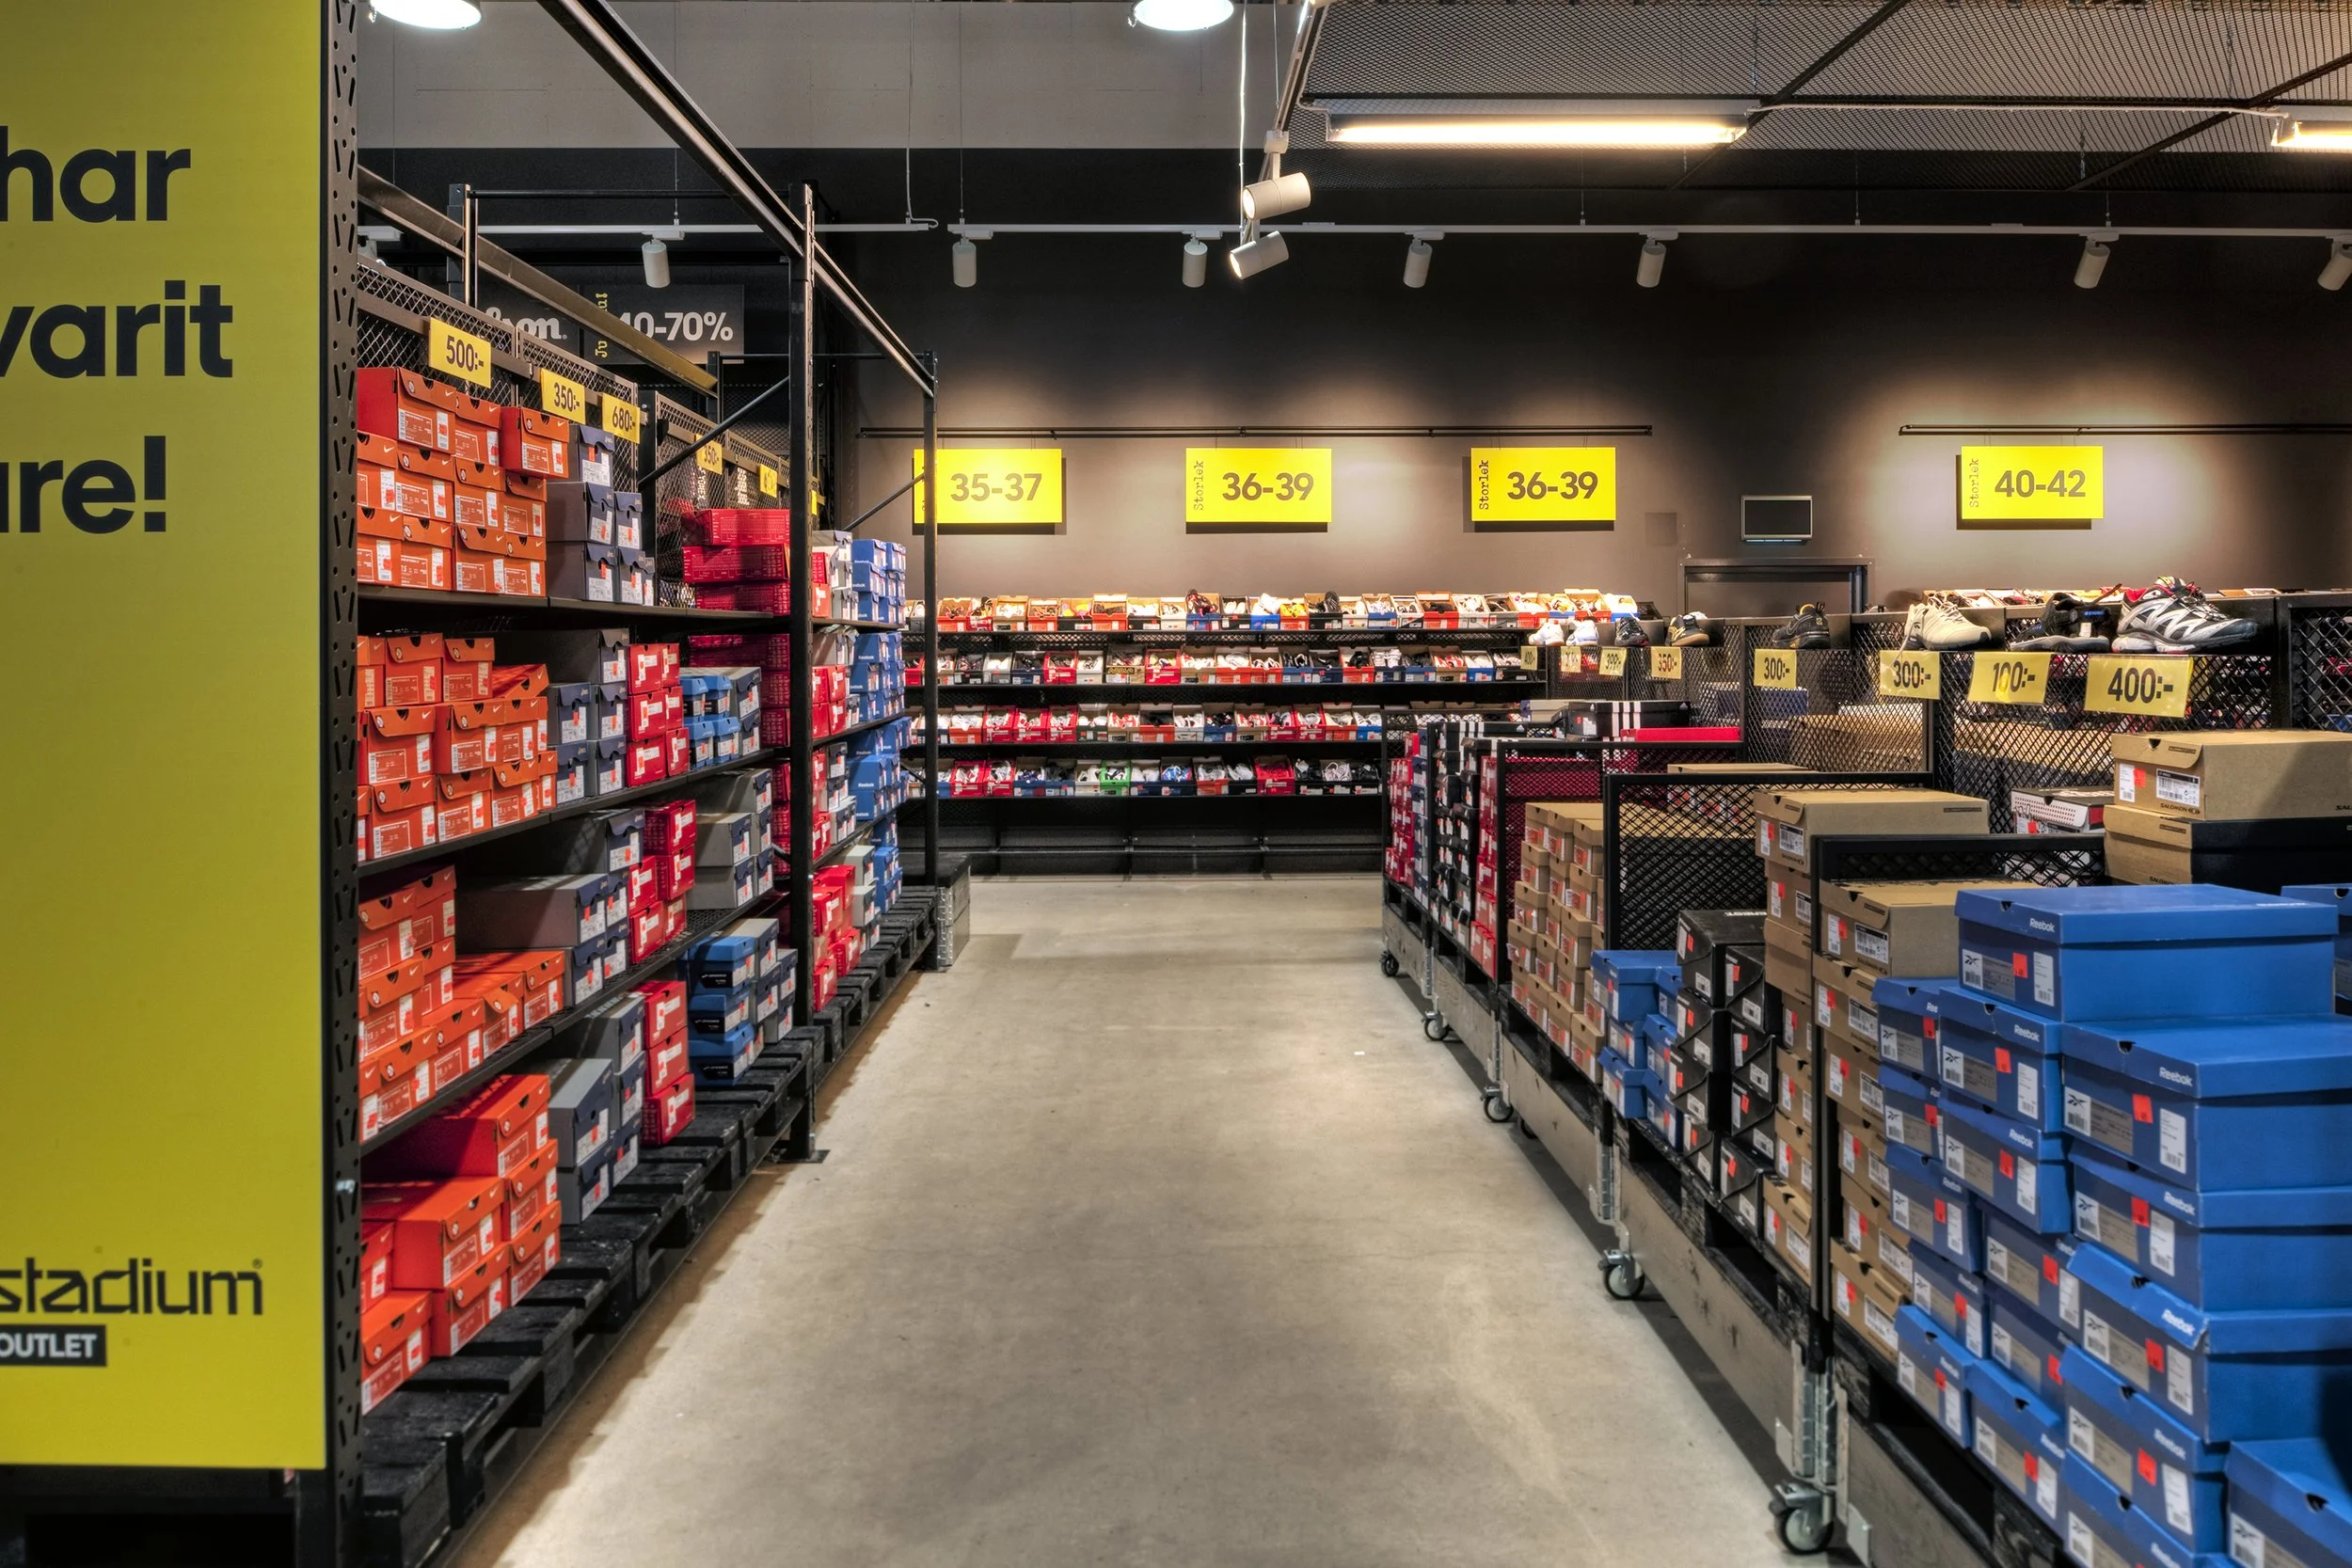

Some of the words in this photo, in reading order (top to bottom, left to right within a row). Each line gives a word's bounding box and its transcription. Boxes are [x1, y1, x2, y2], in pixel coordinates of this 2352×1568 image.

[0, 125, 191, 223] har
[446, 335, 485, 372] 500:-
[553, 382, 580, 412] 350:-
[612, 406, 636, 433] 680:-
[0, 436, 167, 534] re!
[950, 472, 1042, 501] 35-37
[1194, 460, 1204, 511] Storlek
[1222, 472, 1314, 501] 36-39
[1479, 459, 1489, 510] Storlek
[1507, 470, 1598, 500] 36-39
[1969, 458, 1979, 508] Storlek
[1994, 469, 2087, 498] 40-42
[1659, 653, 1677, 673] 350:-
[1764, 657, 1790, 681] 300:-
[1893, 659, 1931, 689] 300:-
[1993, 660, 2036, 693] 100:-
[2107, 667, 2174, 704] 400:-
[2160, 802, 2188, 813] SALOMON
[2029, 917, 2055, 933] Reebok
[1926, 1002, 1938, 1013] Ree
[2013, 1024, 2040, 1042] Reebok
[2158, 1067, 2193, 1087] Reebok
[2009, 1128, 2034, 1149] Reebok
[2164, 1191, 2196, 1216] Reebok
[2161, 1308, 2196, 1337] Reebok
[0, 1333, 98, 1358] OUTLET
[2153, 1428, 2187, 1461] Reebok
